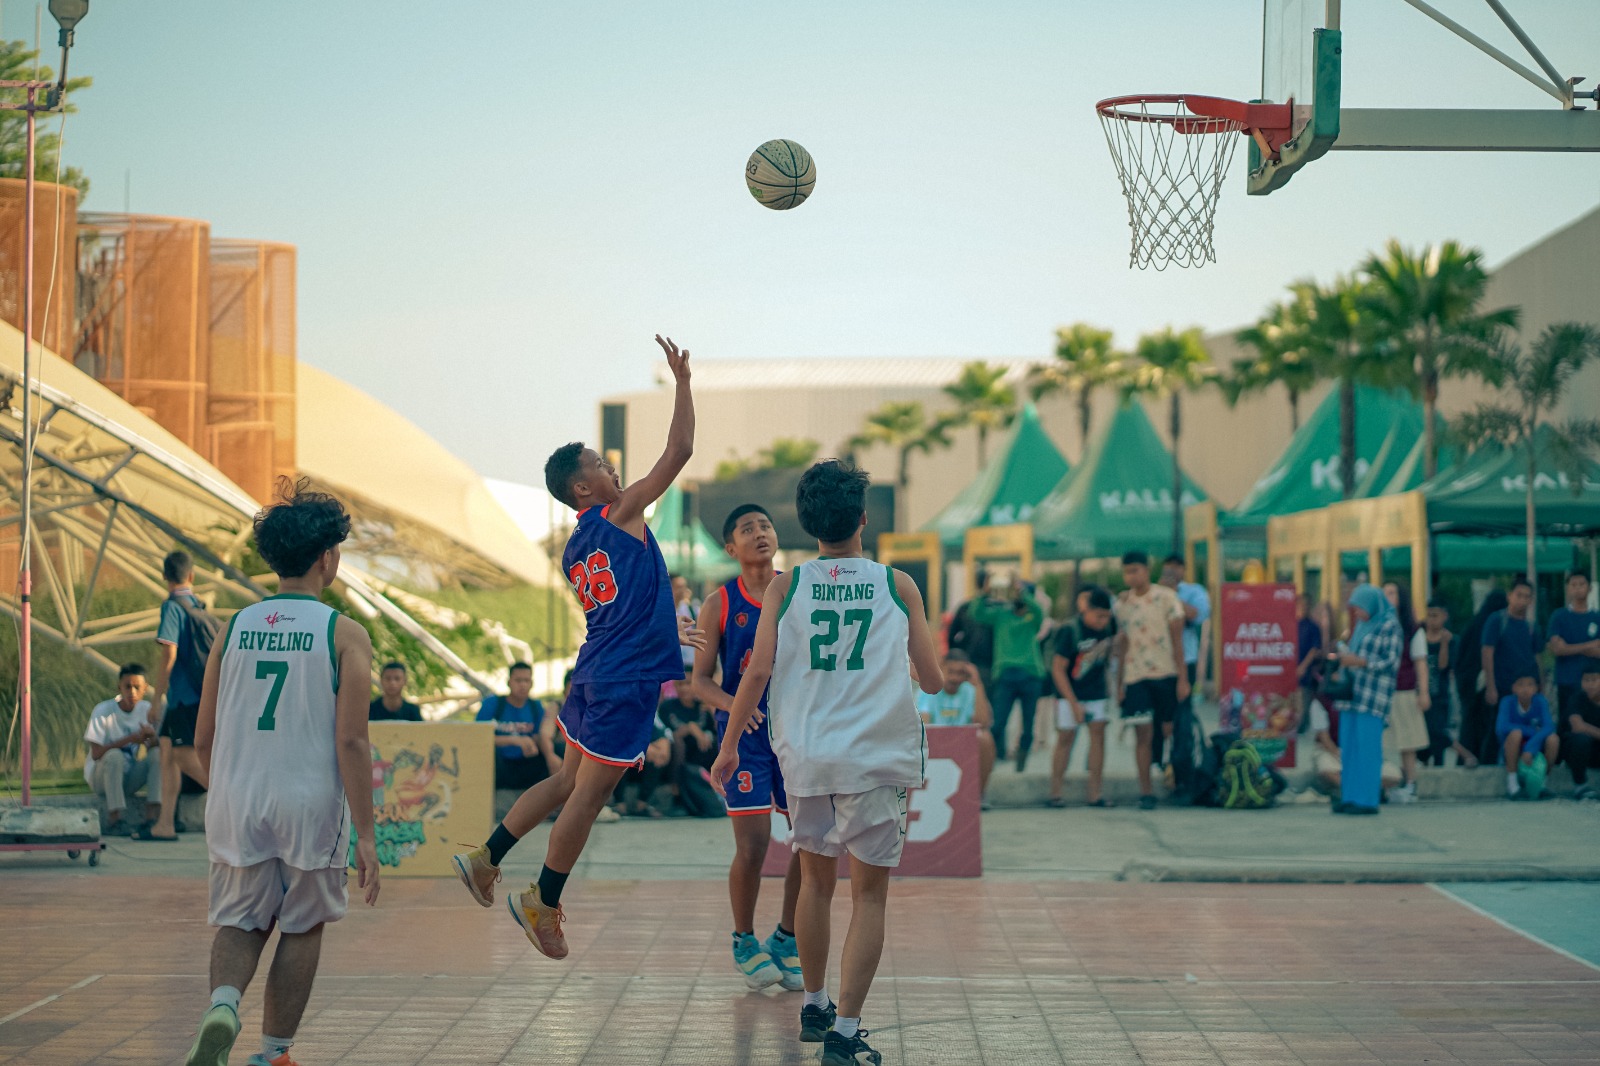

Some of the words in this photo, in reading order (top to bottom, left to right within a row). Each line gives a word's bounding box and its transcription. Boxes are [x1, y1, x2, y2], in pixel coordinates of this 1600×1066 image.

[569, 548, 619, 614] 26
[811, 583, 875, 603] BINTANG
[238, 630, 314, 652] RIVELINO
[810, 608, 873, 672] 27
[1235, 622, 1284, 640] AREA
[1223, 641, 1295, 660] KULINER
[255, 660, 289, 731] 7
[737, 770, 754, 793] 3
